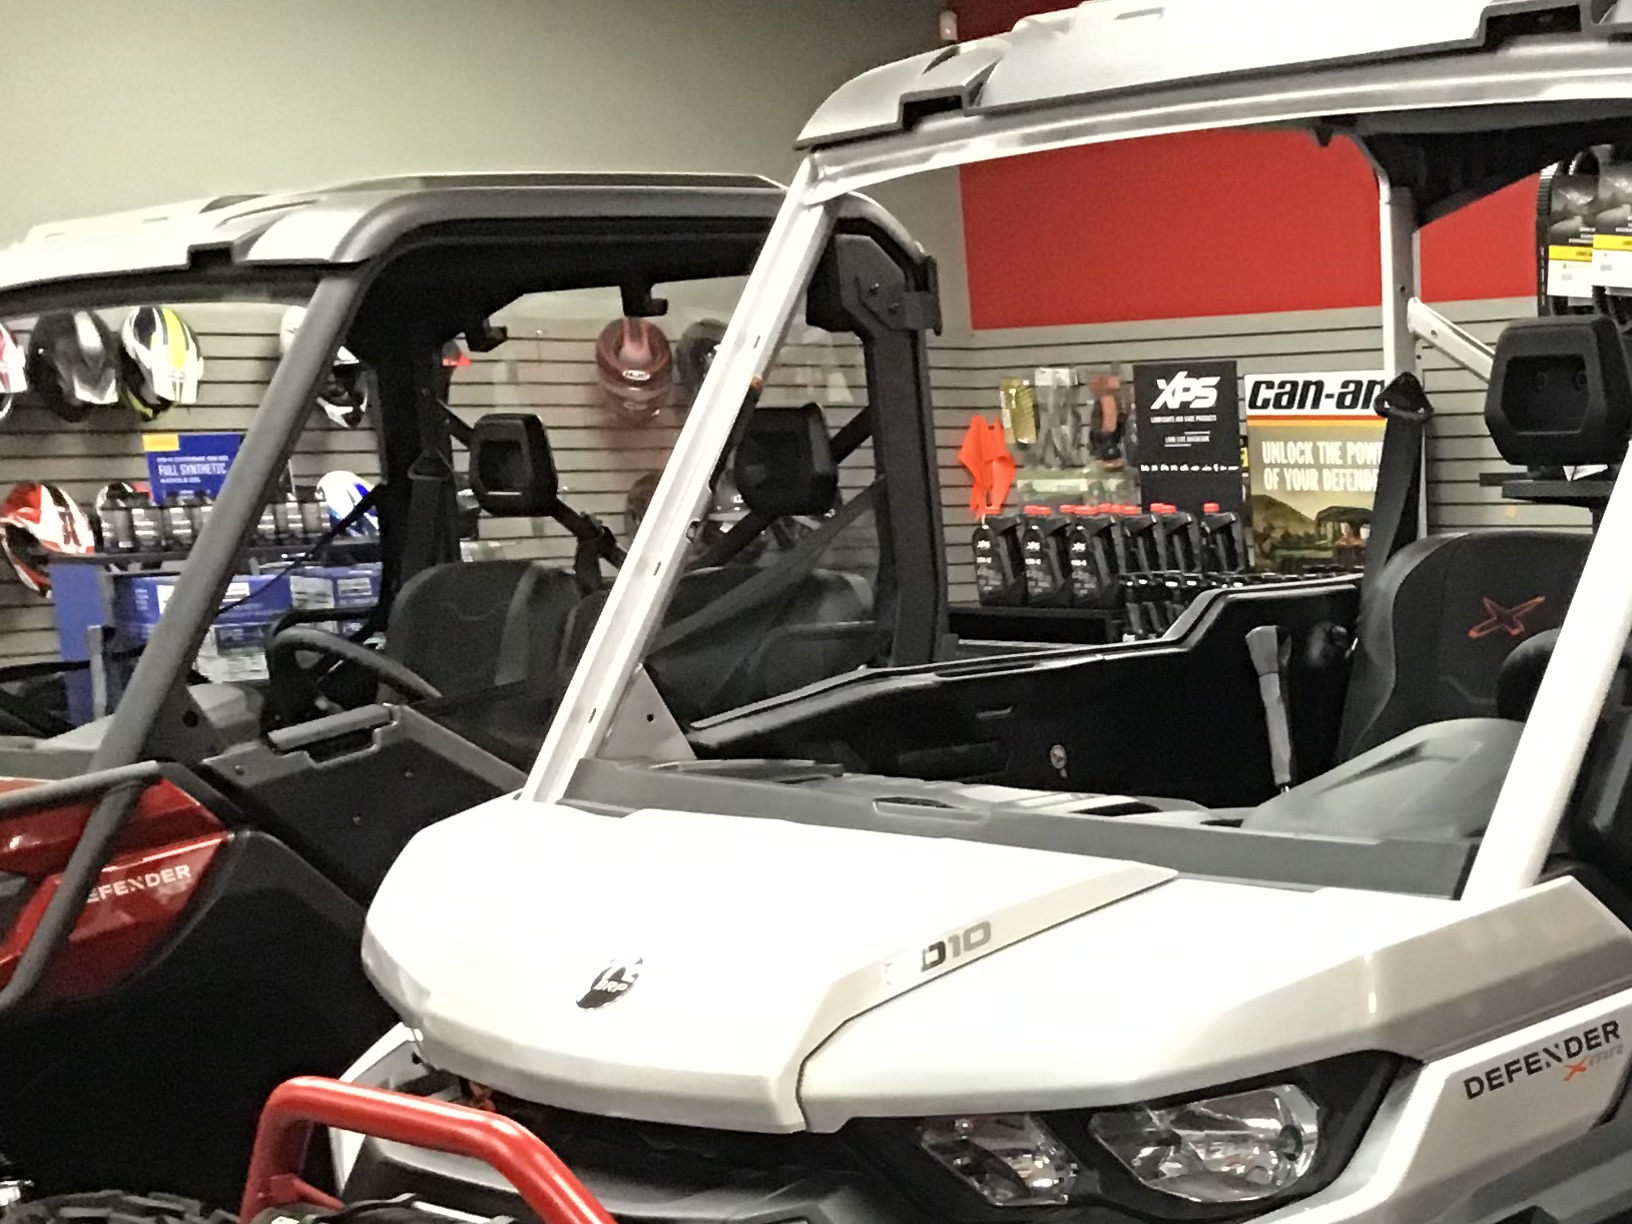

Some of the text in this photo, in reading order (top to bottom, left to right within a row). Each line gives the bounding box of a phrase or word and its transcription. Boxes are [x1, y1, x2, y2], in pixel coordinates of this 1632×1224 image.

[1150, 371, 1221, 410] XPS
[1261, 441, 1315, 465] UNLOCK
[1317, 441, 1343, 465] THE
[1263, 468, 1280, 491] OF
[1283, 468, 1319, 492] YOUR
[86, 864, 191, 904] EFENDER
[921, 921, 991, 973] D10
[1463, 1020, 1620, 1100] DEFENDER
